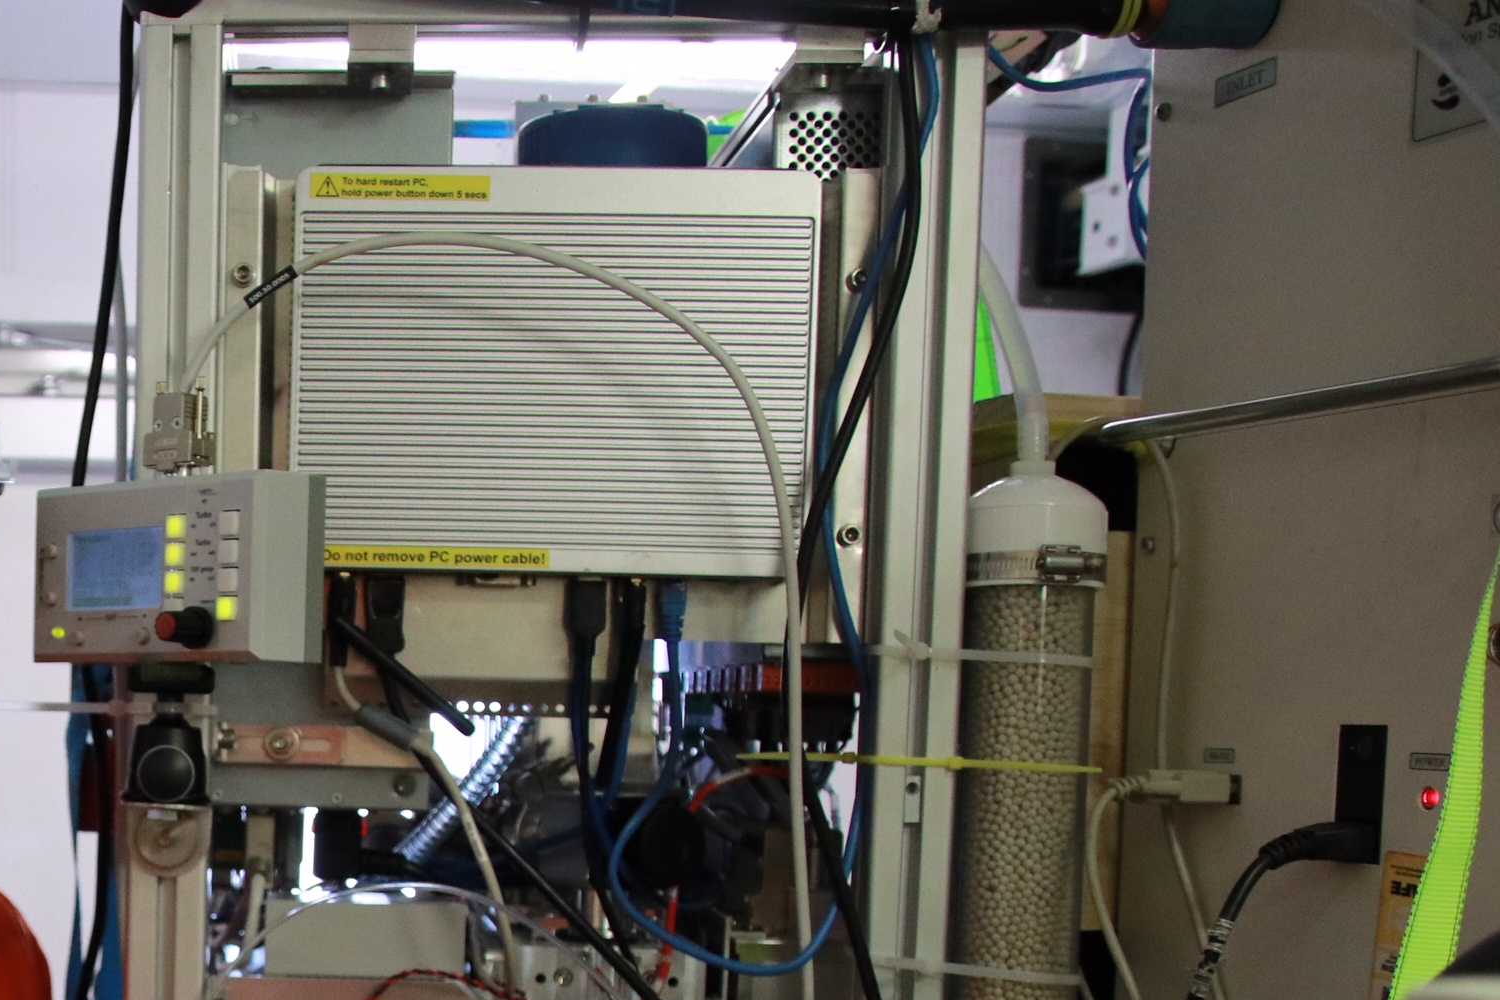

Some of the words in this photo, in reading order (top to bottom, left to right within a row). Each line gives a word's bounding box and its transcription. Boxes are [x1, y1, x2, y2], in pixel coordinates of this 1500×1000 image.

[341, 177, 352, 185] To
[355, 177, 377, 186] hard
[379, 178, 411, 186] restart
[340, 189, 362, 197] hold
[364, 190, 393, 199] power
[395, 189, 426, 198] button
[428, 190, 453, 198] down
[456, 191, 463, 199] 5
[323, 550, 341, 561] Do
[344, 551, 369, 561] not
[372, 552, 425, 563] remove
[429, 551, 450, 562] PC
[454, 553, 498, 565] power
[502, 552, 546, 564] cable!
